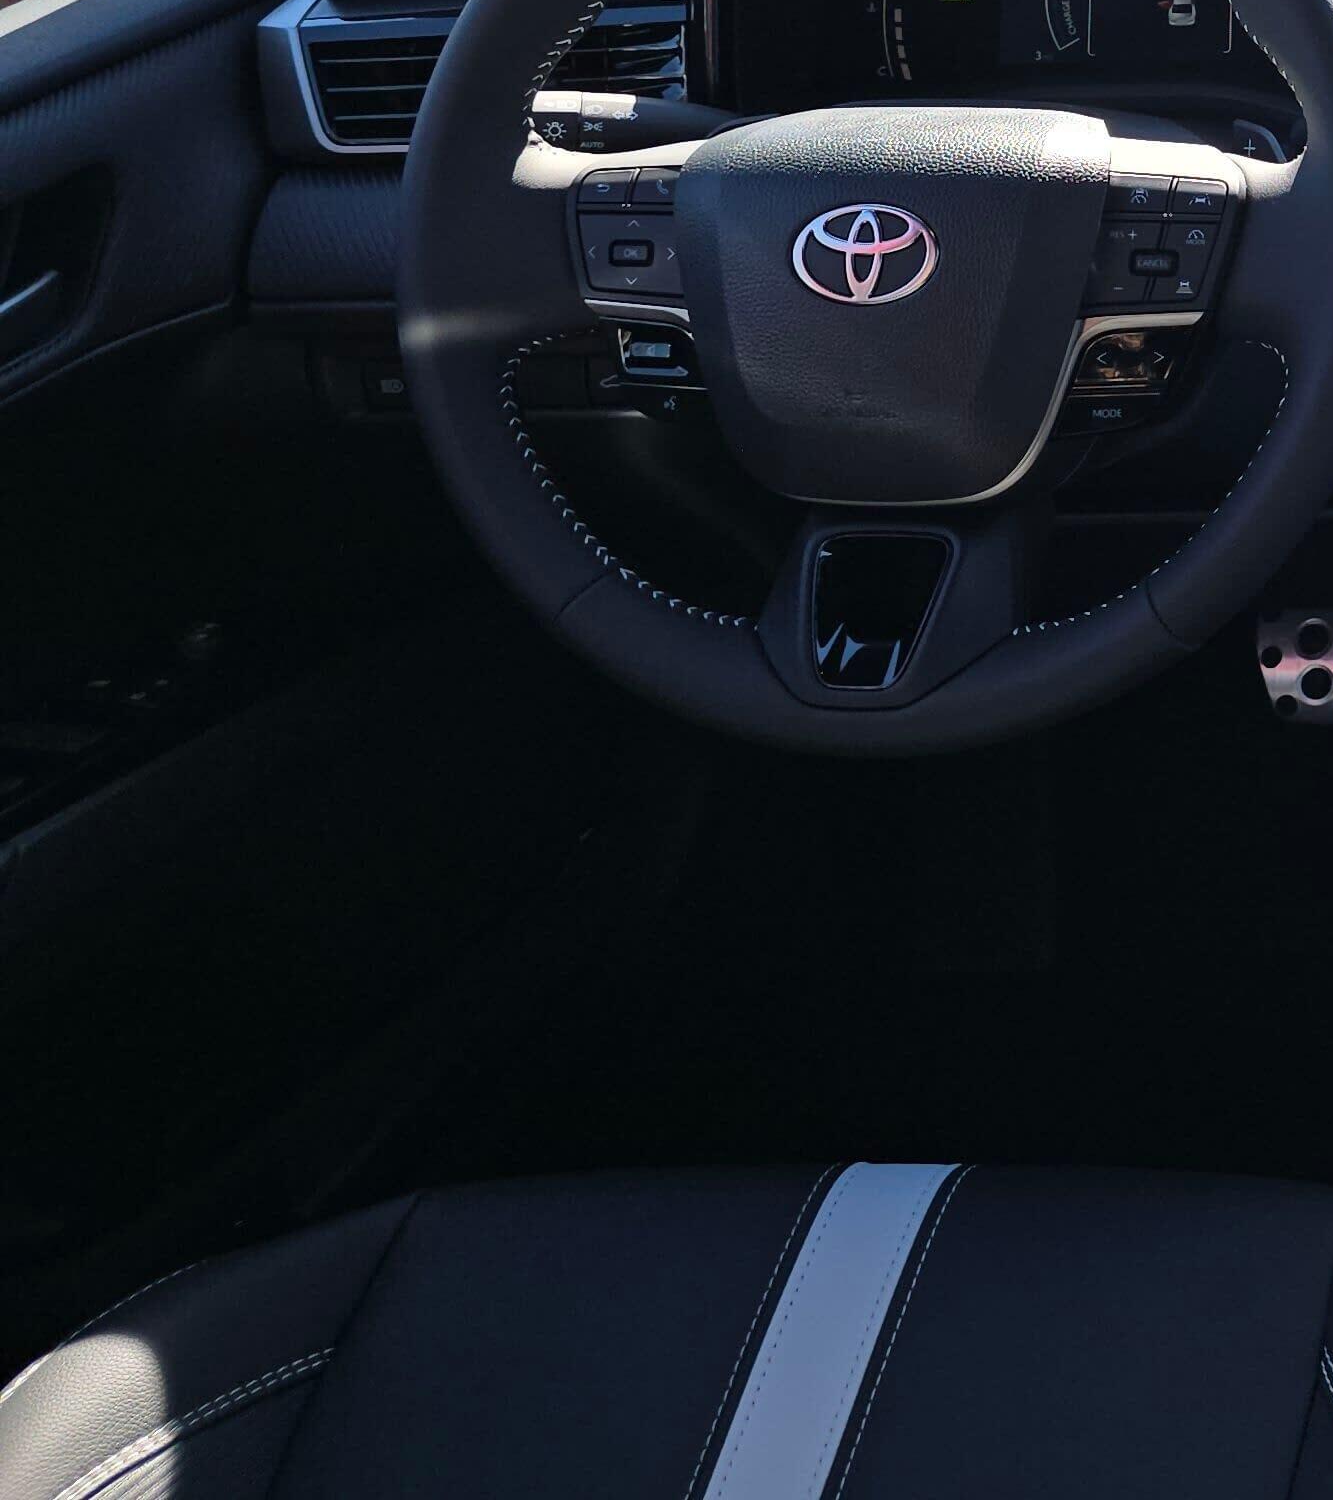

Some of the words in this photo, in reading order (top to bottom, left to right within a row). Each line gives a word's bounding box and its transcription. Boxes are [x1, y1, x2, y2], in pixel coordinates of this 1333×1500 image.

[580, 141, 605, 149] AUTO
[623, 248, 639, 259] OK
[1092, 408, 1122, 419] MODE
